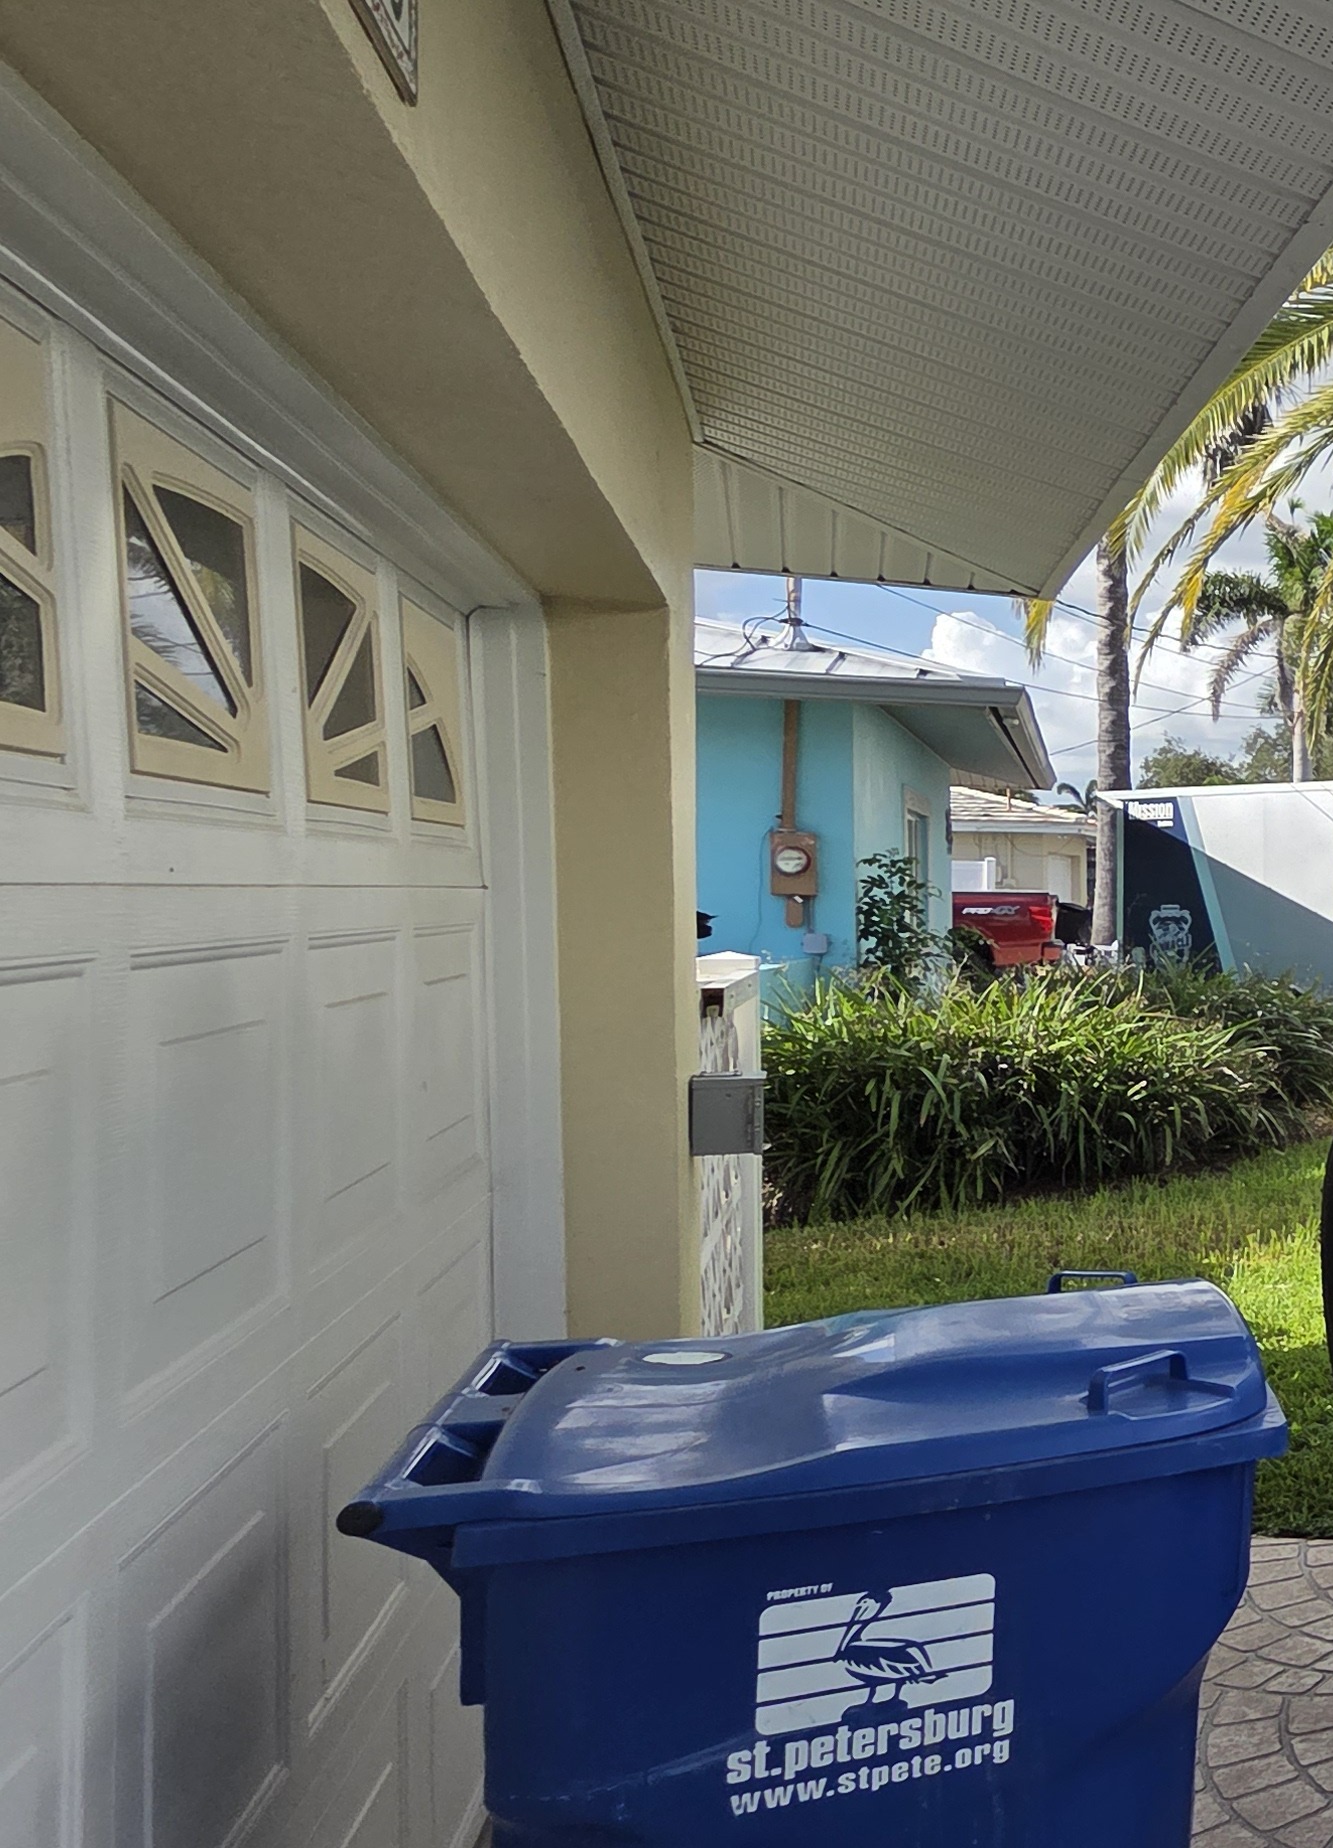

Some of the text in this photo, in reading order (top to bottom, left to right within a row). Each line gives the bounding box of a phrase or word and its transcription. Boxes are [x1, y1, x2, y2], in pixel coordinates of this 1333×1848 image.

[766, 1582, 834, 1601] PROPERTY OF
[726, 1699, 1014, 1785] st.petersburg
[730, 1739, 1010, 1816] www.stpete.org
